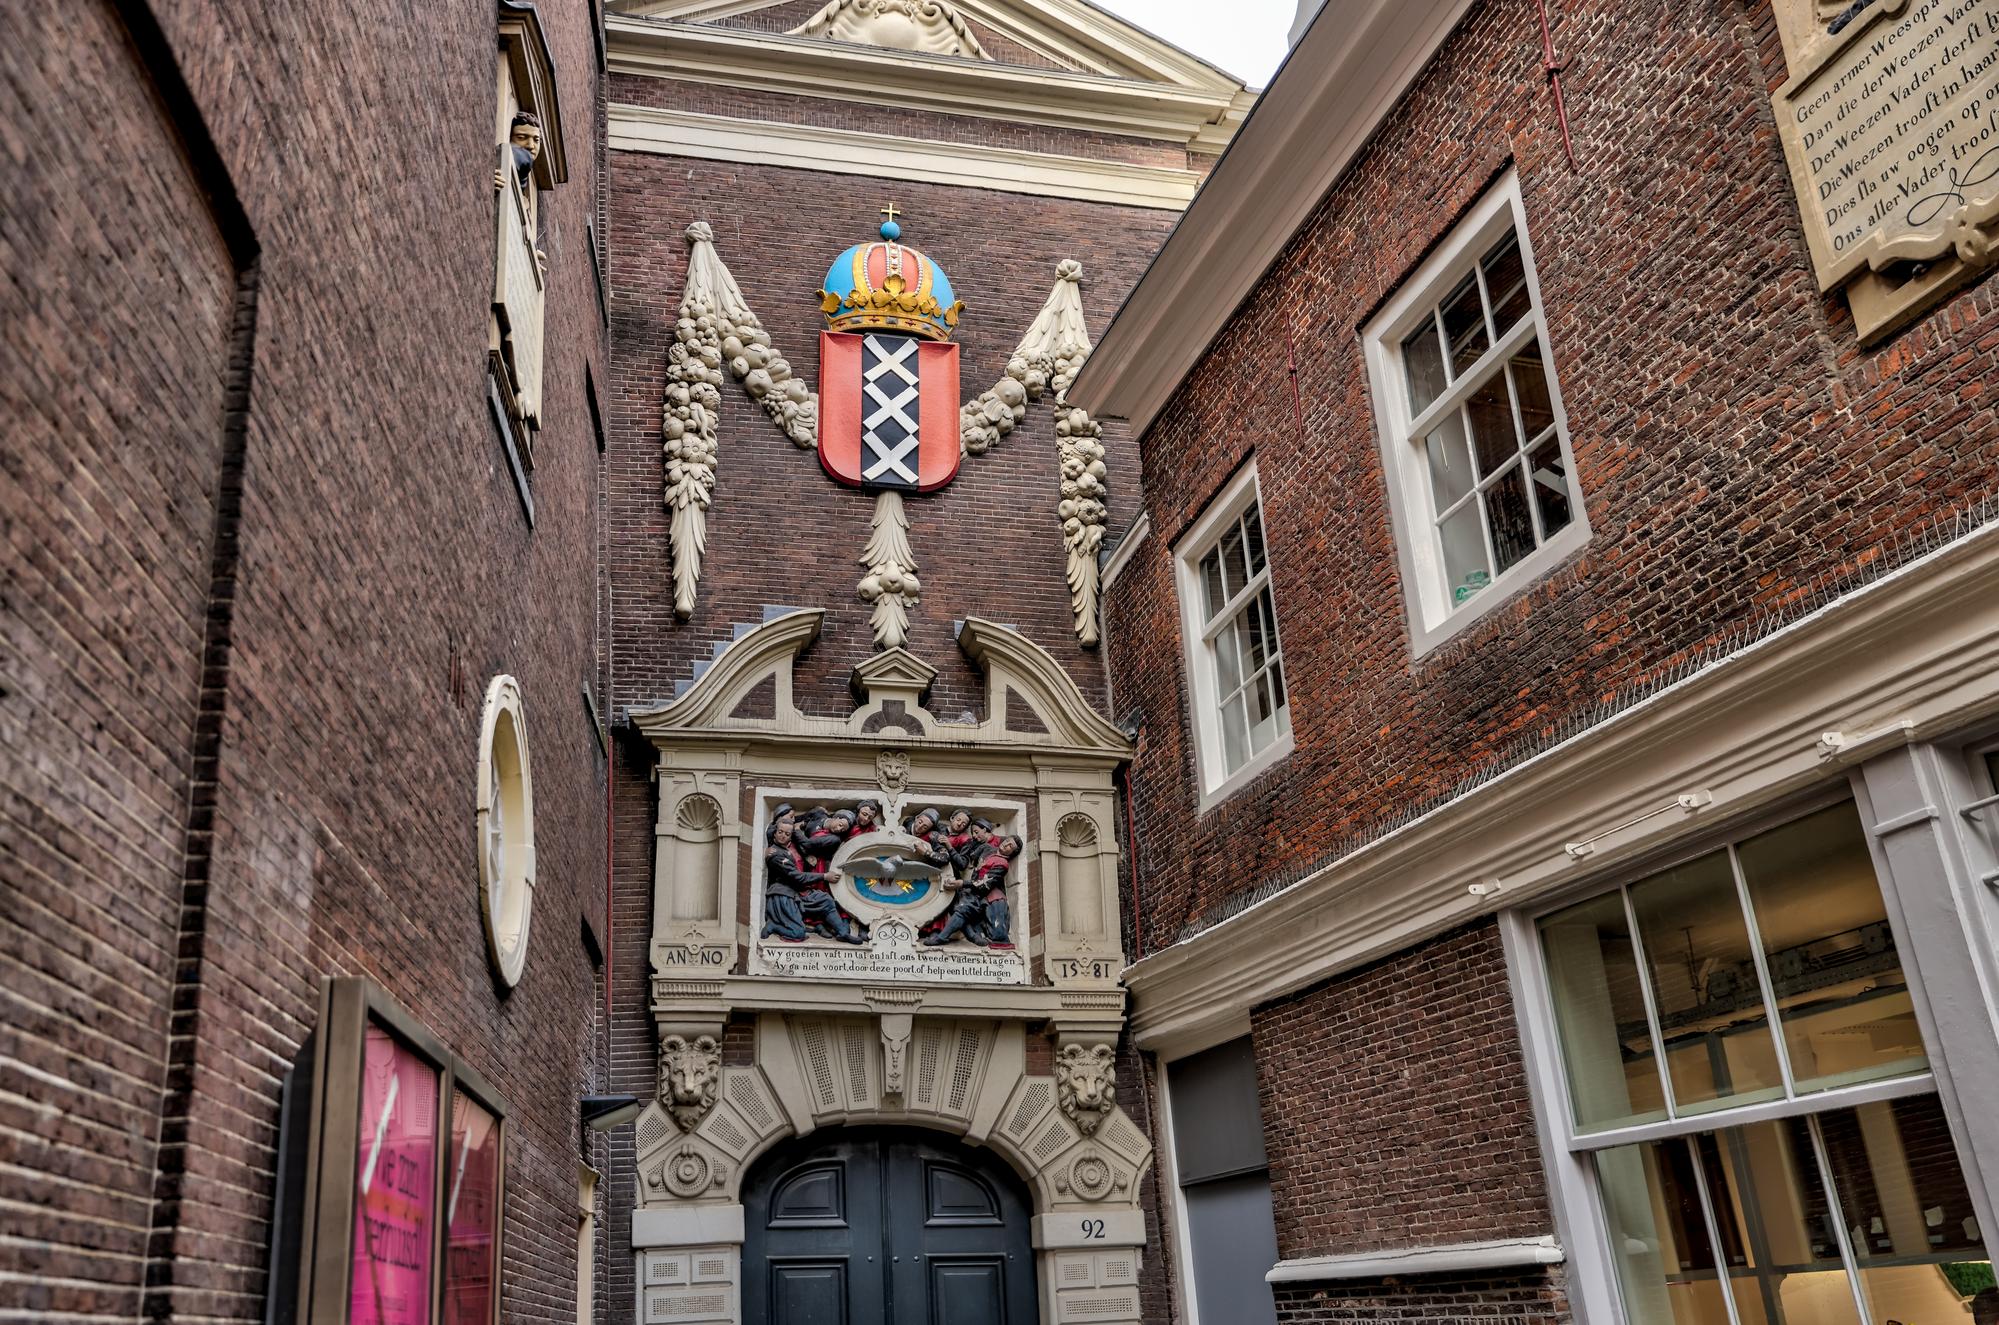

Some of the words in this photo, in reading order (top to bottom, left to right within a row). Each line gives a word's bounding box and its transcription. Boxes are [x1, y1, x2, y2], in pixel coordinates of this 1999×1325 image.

[1797, 90, 1831, 124] Geen
[1833, 53, 1873, 93] armer
[1870, 20, 1912, 57] Wees
[1913, 5, 1929, 23] op
[1802, 119, 1833, 151] Dan
[1837, 97, 1858, 122] die
[1861, 74, 1885, 100] der
[1883, 25, 1944, 78] Weezen
[1810, 146, 1837, 175] Der
[1834, 102, 1892, 152] Weezen
[1889, 63, 1937, 105] Vader
[1819, 176, 1842, 201] Die
[1840, 135, 1894, 177] Weezen
[1943, 81, 1961, 100] in
[1960, 48, 1999, 84] haar
[1825, 197, 1856, 228] Dies
[1881, 160, 1900, 183] uw
[1908, 119, 1955, 161] oogen
[1962, 99, 1981, 120] op
[1834, 224, 1863, 251] Ons
[1868, 194, 1901, 227] aller
[1897, 158, 1947, 198] Vader
[900, 953, 915, 961] ons
[1081, 1219, 1106, 1239] 92
